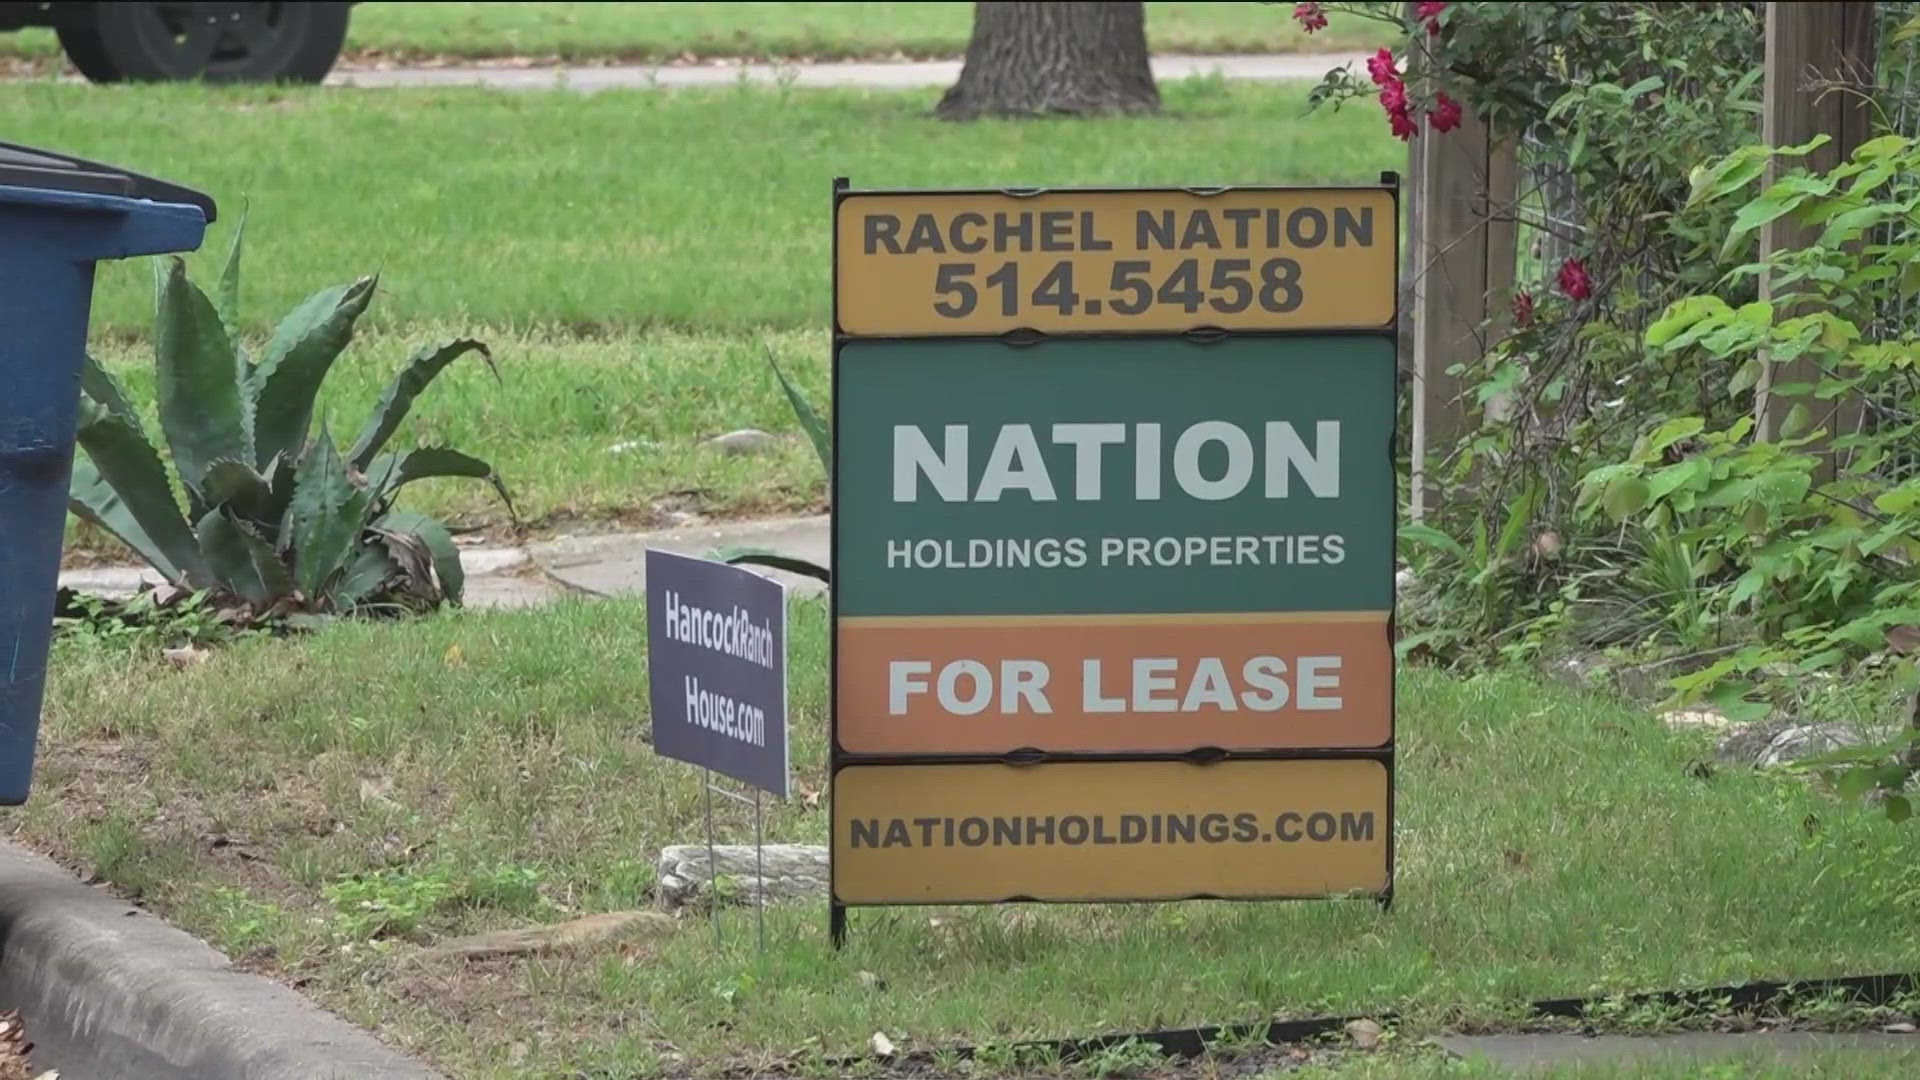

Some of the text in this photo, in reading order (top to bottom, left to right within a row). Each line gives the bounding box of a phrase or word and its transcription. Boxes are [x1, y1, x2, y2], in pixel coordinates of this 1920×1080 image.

[863, 207, 1374, 255] RACHEL NATION
[933, 257, 1304, 319] 514.5458
[893, 420, 1342, 502] NATION
[886, 534, 1346, 571] HOLDINGS PROPERTIES
[665, 589, 774, 669] HancockRanch
[685, 674, 765, 748] House.com
[888, 655, 1344, 716] FOR LEASE
[850, 811, 1375, 849] NATIONHOLDINGS.COM
